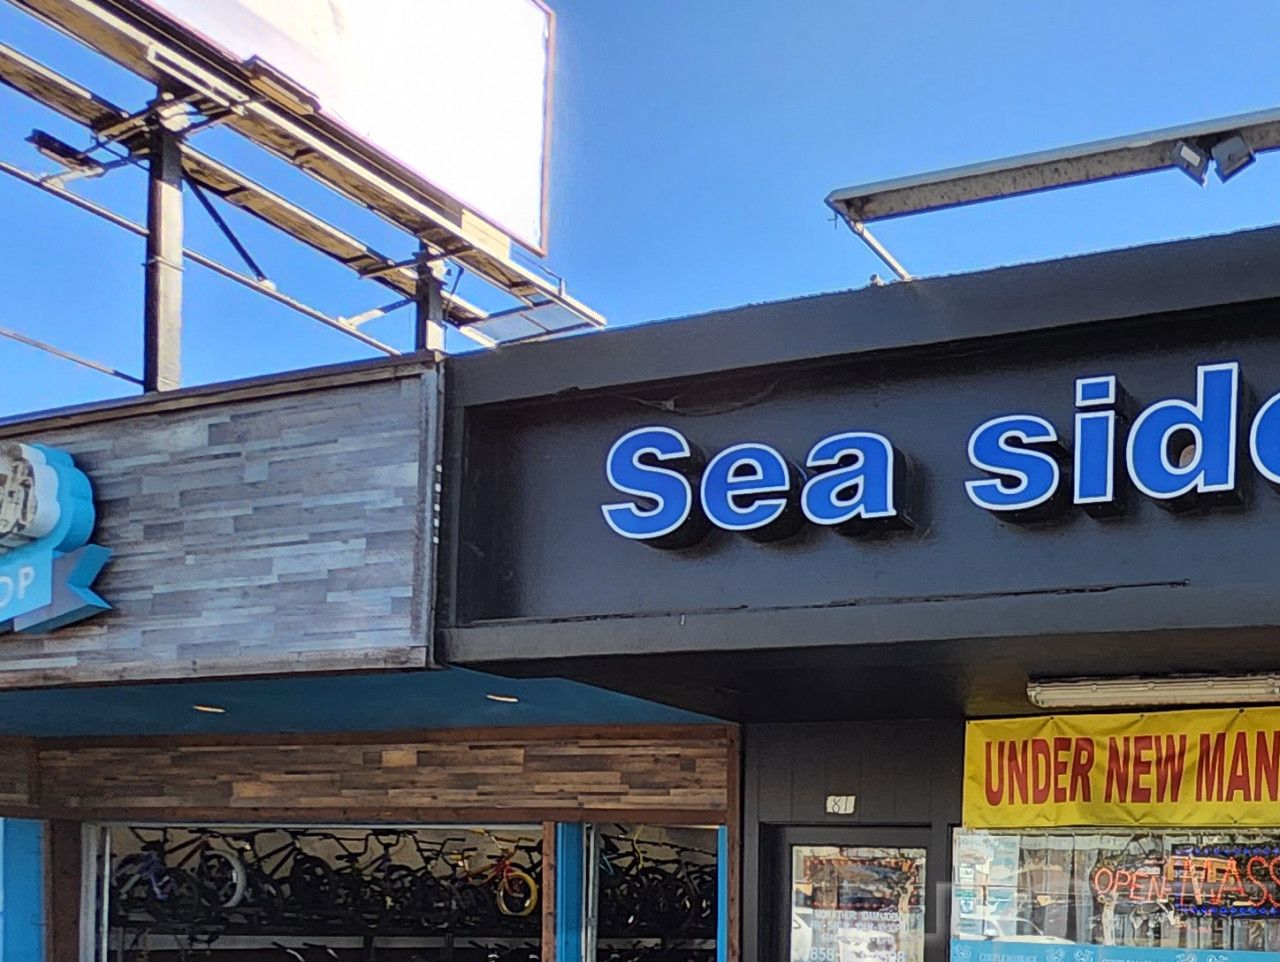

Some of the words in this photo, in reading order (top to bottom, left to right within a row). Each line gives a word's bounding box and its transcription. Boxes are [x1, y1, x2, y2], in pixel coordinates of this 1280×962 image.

[602, 426, 897, 540] Sea
[984, 736, 1096, 807] UNDER
[1105, 734, 1188, 804] NEW
[1094, 865, 1169, 903] OPEN
[979, 953, 1006, 962] COUPLE
